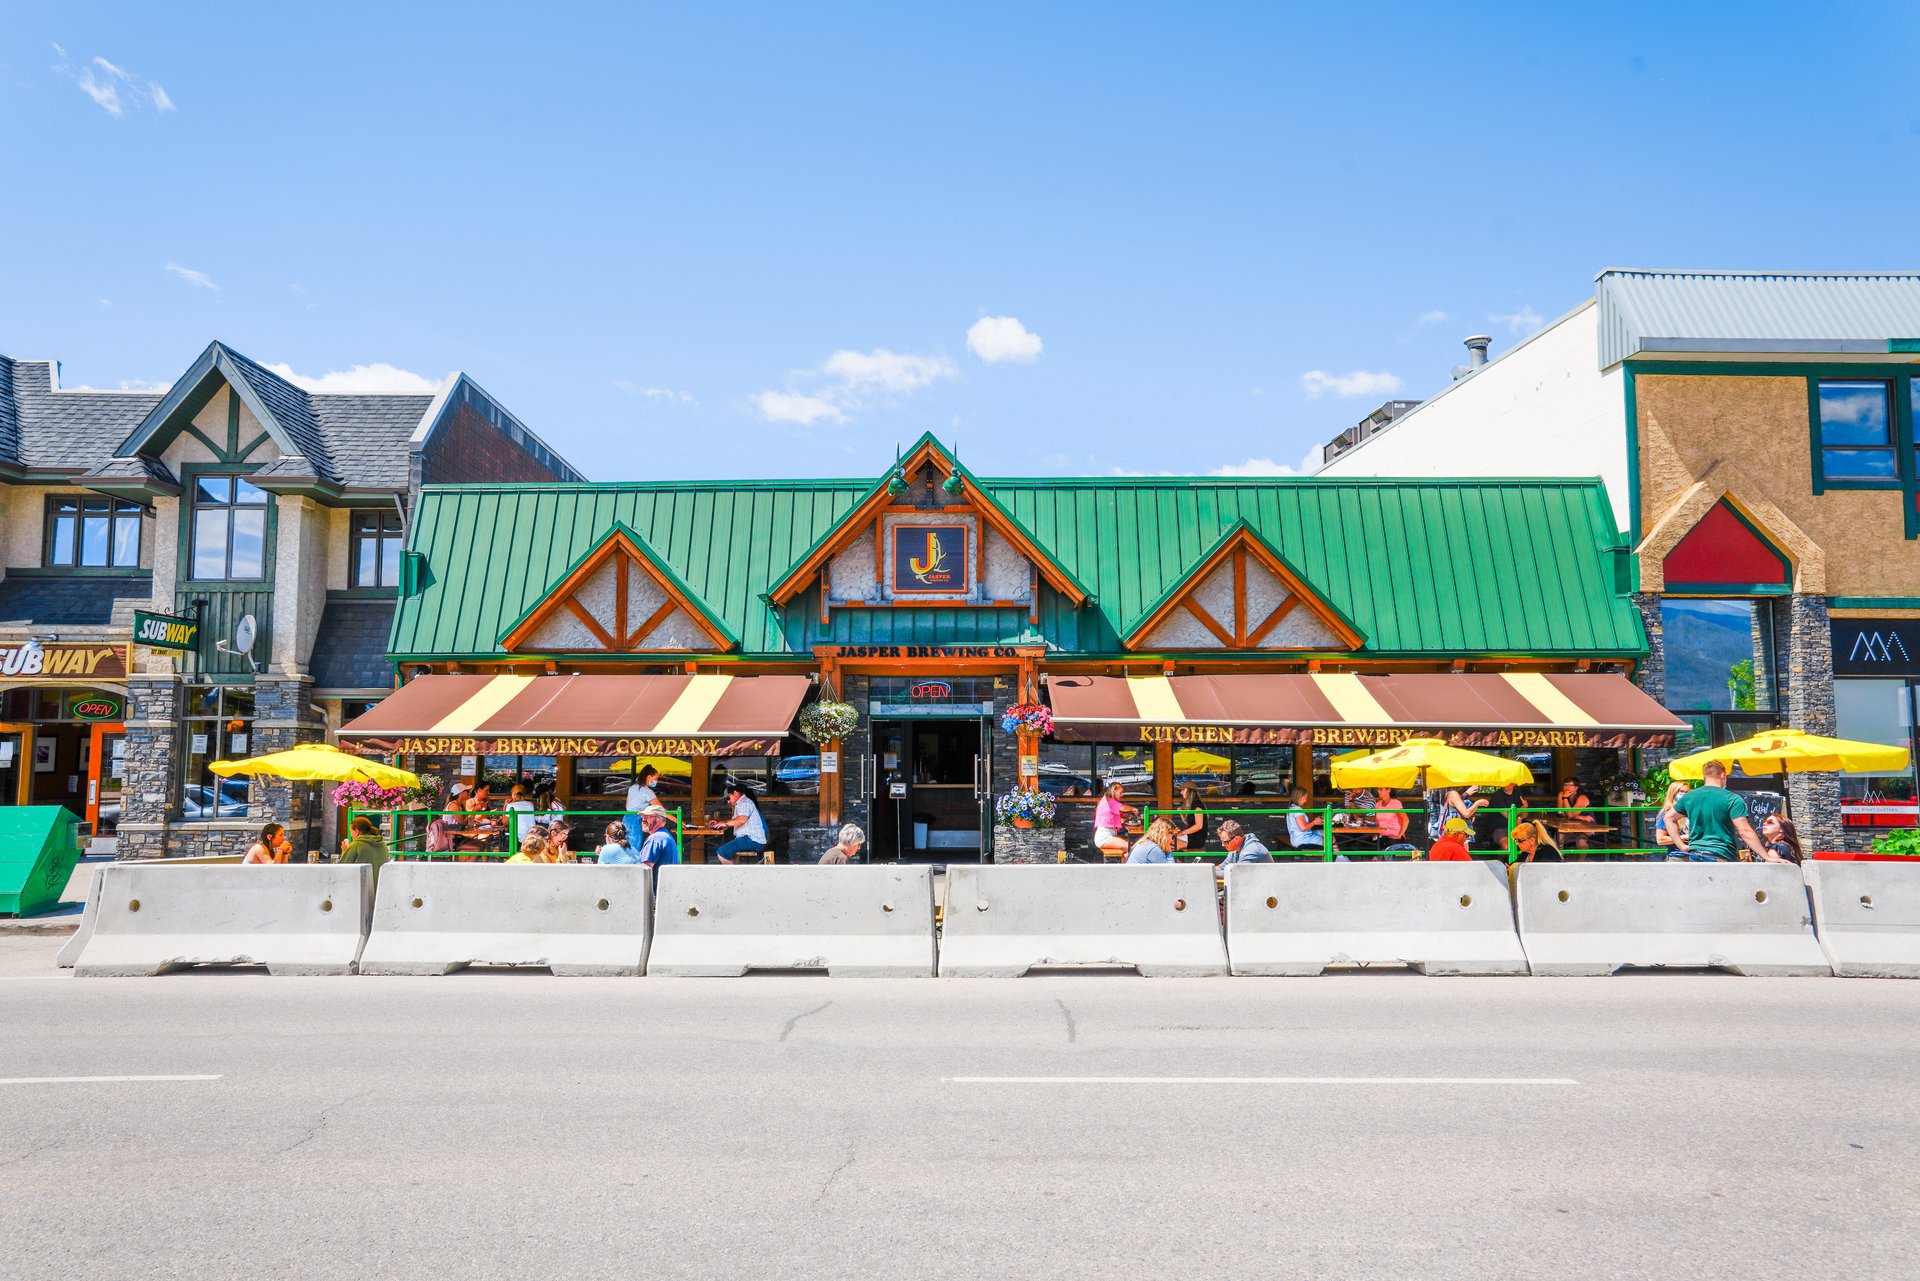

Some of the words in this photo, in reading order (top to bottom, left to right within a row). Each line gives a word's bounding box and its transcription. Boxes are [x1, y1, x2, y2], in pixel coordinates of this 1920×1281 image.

[138, 619, 197, 644] SUBWAY
[836, 646, 901, 657] JASPER
[907, 646, 989, 657] BREWING
[994, 646, 1020, 657] CO.
[911, 685, 949, 698] OPEN
[78, 703, 113, 715] OPEN
[1139, 726, 1234, 742] KITCHEN
[1312, 727, 1415, 744] BREWERY
[1496, 730, 1590, 746] APPAREL
[399, 738, 477, 754] JASPER
[496, 738, 598, 754] BREWING
[615, 738, 721, 755] COMPANY
